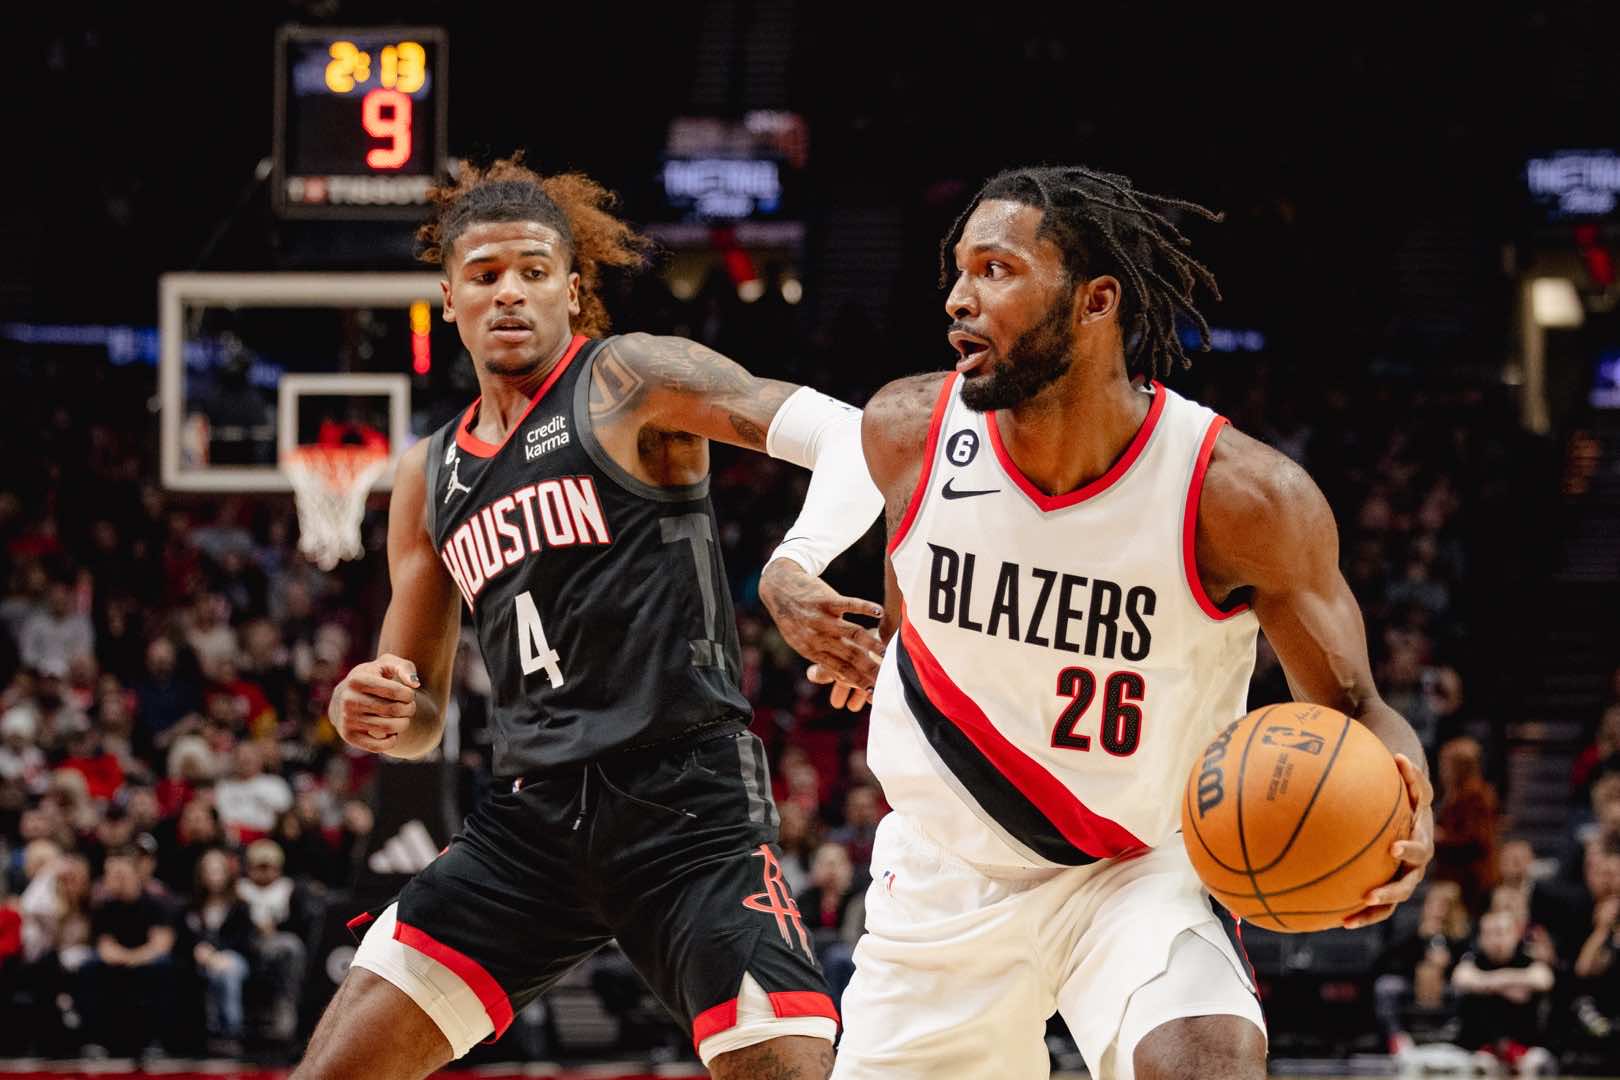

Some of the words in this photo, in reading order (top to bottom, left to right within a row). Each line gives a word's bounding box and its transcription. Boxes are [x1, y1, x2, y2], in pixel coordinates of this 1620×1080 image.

[325, 41, 426, 93] 2:13
[362, 88, 412, 169] 9
[525, 431, 570, 461] karma
[527, 415, 566, 444] credit
[951, 432, 975, 463] 6
[442, 475, 613, 616] HOUSTON
[515, 590, 564, 689] 4
[927, 542, 1157, 662] BLAZERS
[1050, 665, 1146, 758] 26
